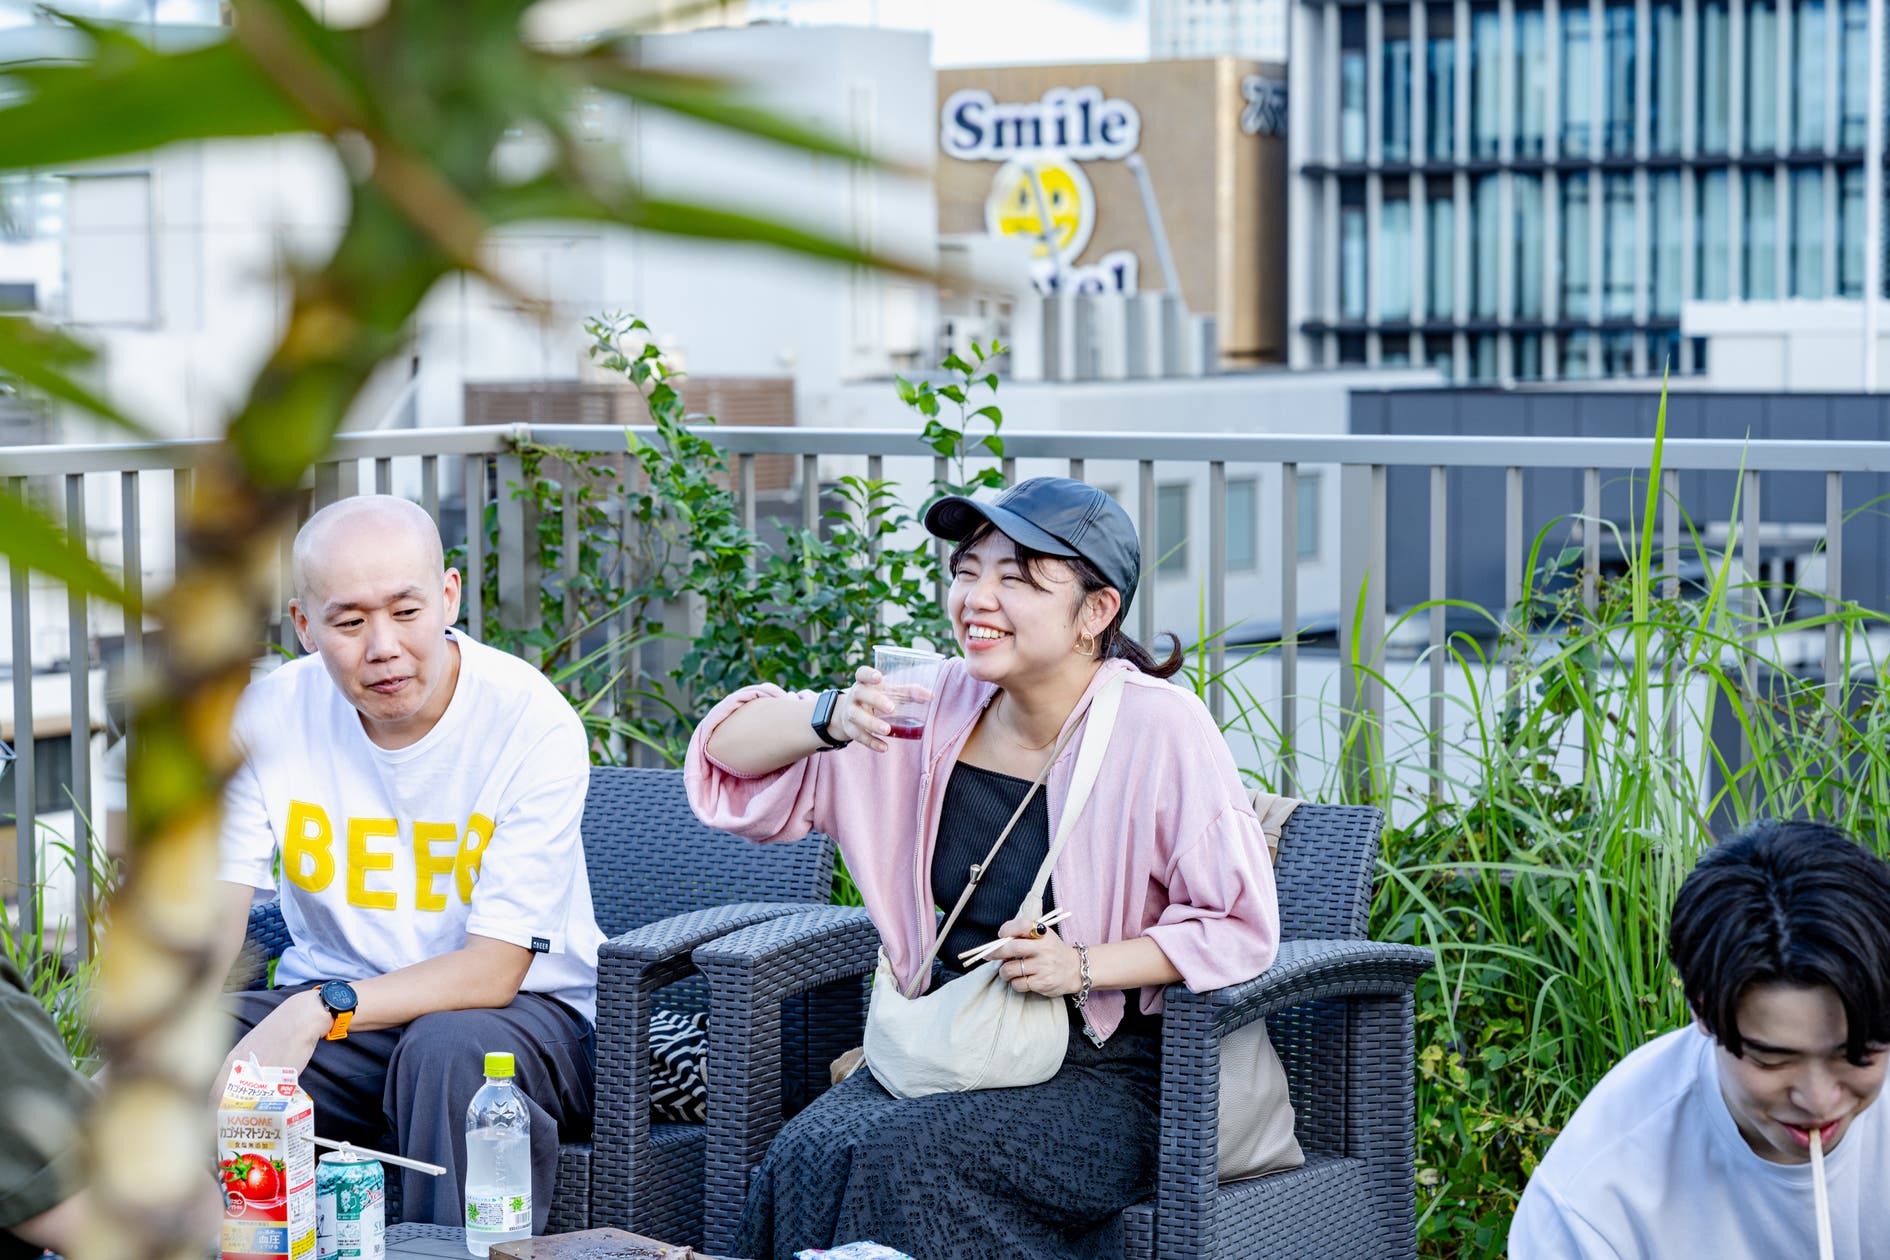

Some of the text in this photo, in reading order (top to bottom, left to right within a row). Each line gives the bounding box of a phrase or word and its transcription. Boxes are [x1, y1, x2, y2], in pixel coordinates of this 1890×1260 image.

[950, 98, 1128, 149] Smile
[283, 799, 496, 912] BEER
[219, 1127, 282, 1140] カゴメトマトジュース
[227, 1116, 273, 1127] KAGOME
